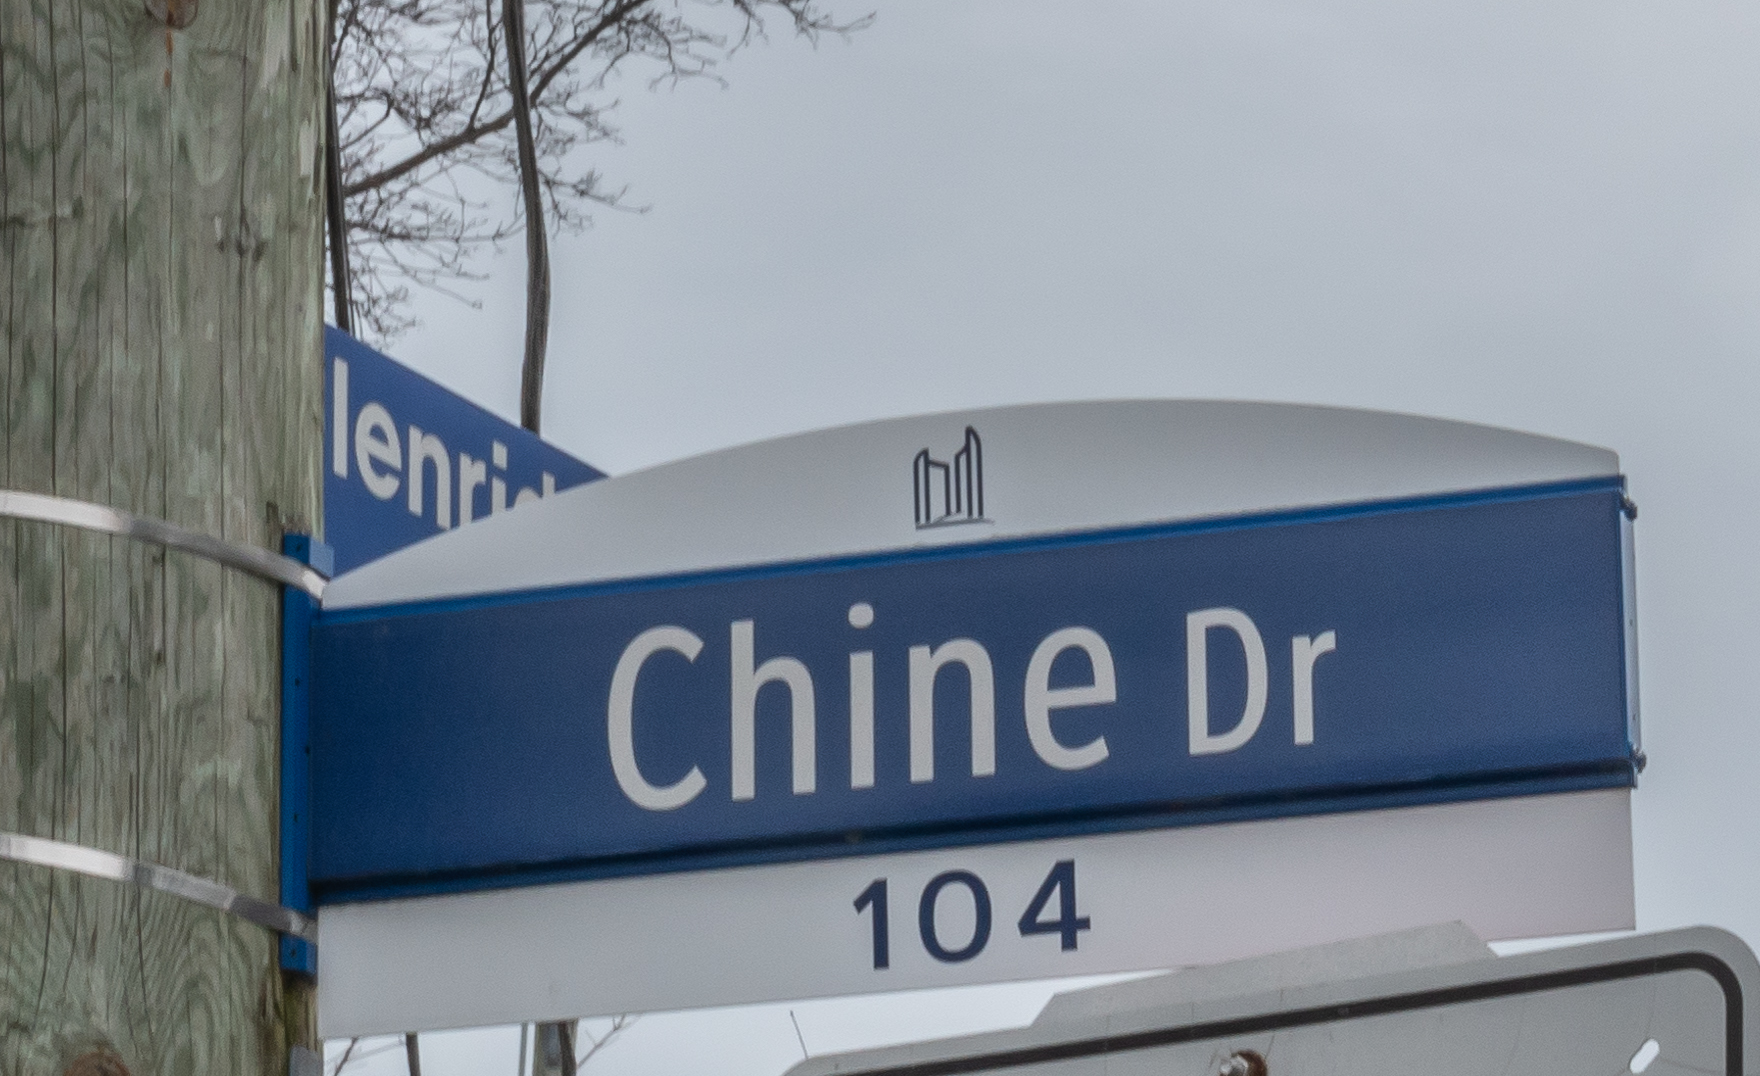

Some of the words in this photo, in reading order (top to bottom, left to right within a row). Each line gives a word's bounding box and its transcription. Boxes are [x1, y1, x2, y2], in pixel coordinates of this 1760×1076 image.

[607, 603, 1117, 811] Chine
[1186, 607, 1336, 757] Dr
[852, 859, 1091, 971] 104
